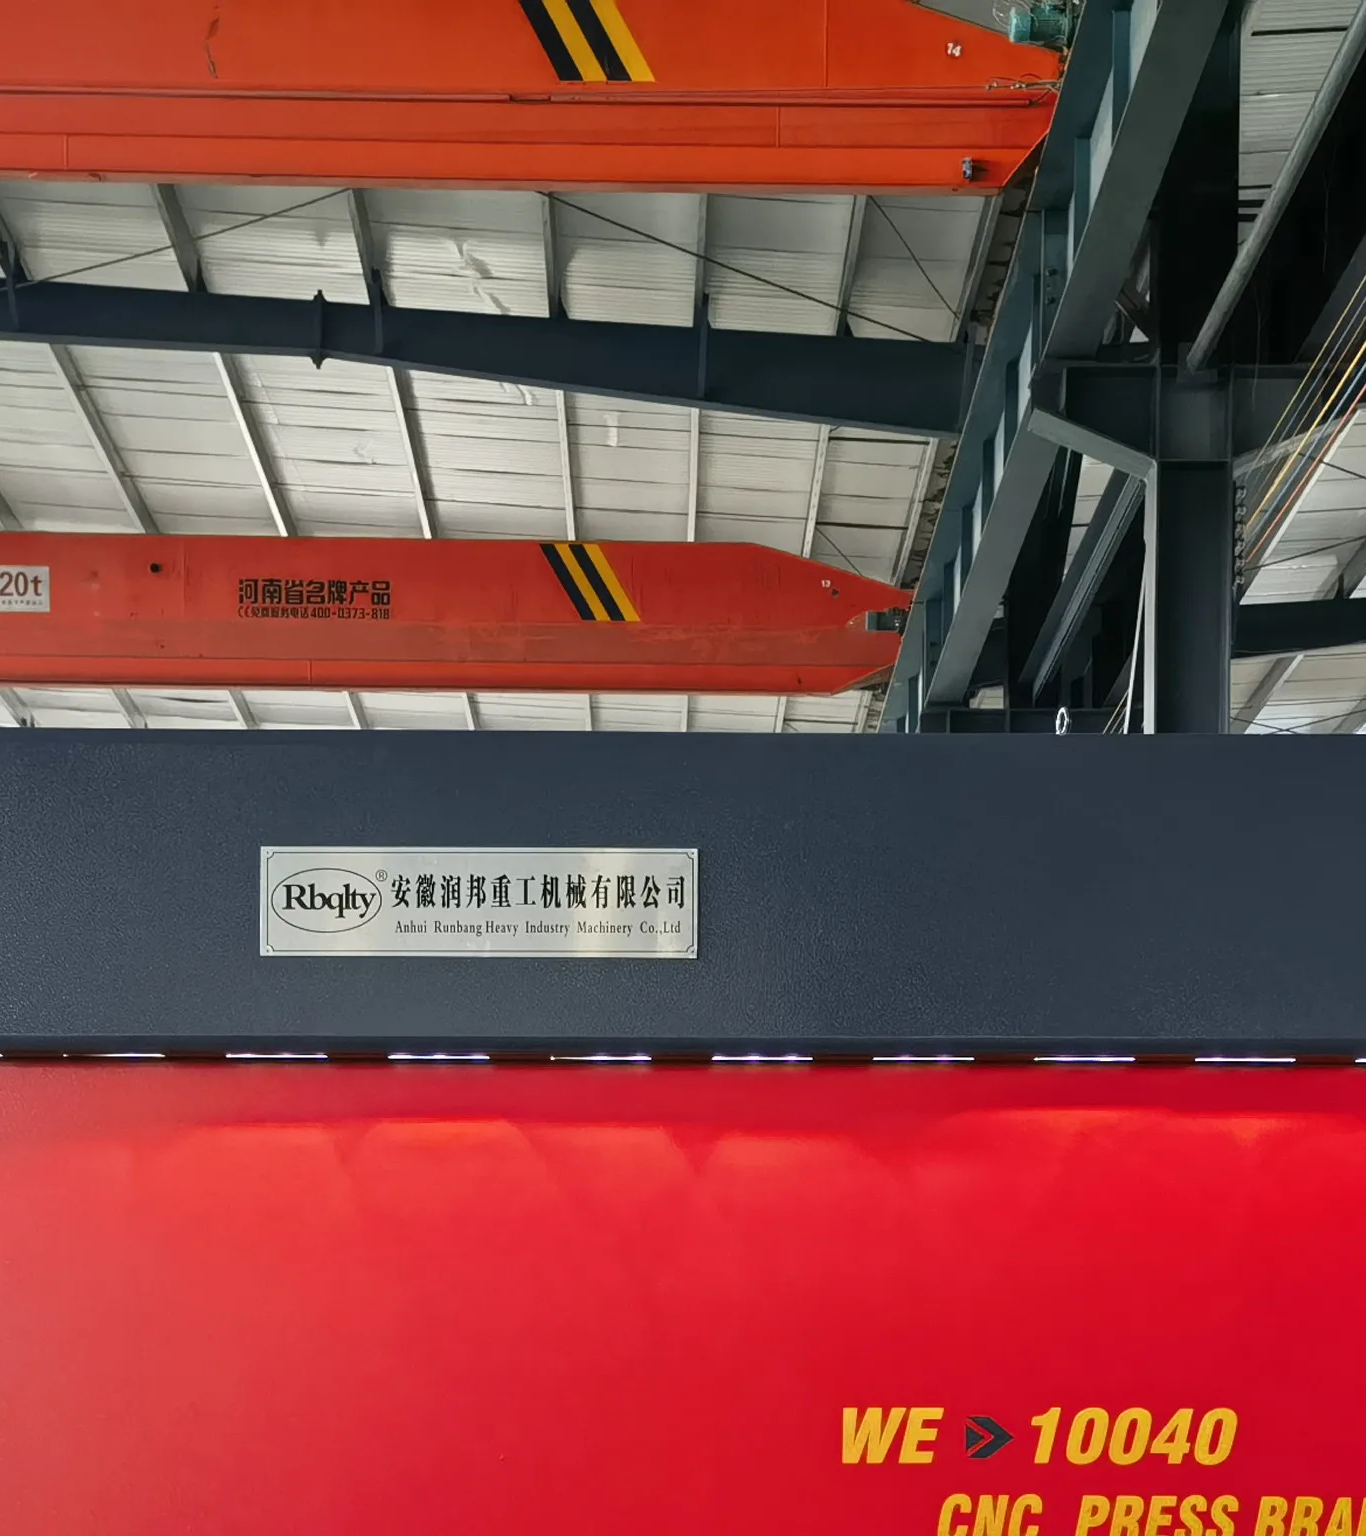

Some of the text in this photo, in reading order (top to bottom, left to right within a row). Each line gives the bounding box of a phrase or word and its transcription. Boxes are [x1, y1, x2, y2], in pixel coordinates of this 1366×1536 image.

[238, 578, 391, 606] 河南省名牌产品
[391, 873, 685, 910] 安徽润邦重工机械有限公司
[395, 920, 428, 934] Anhui
[433, 920, 483, 937] Runbang
[485, 920, 519, 937] Heavy
[525, 920, 570, 937] Industry
[577, 920, 634, 937] Machinery
[841, 1406, 1238, 1466] WE 10040
